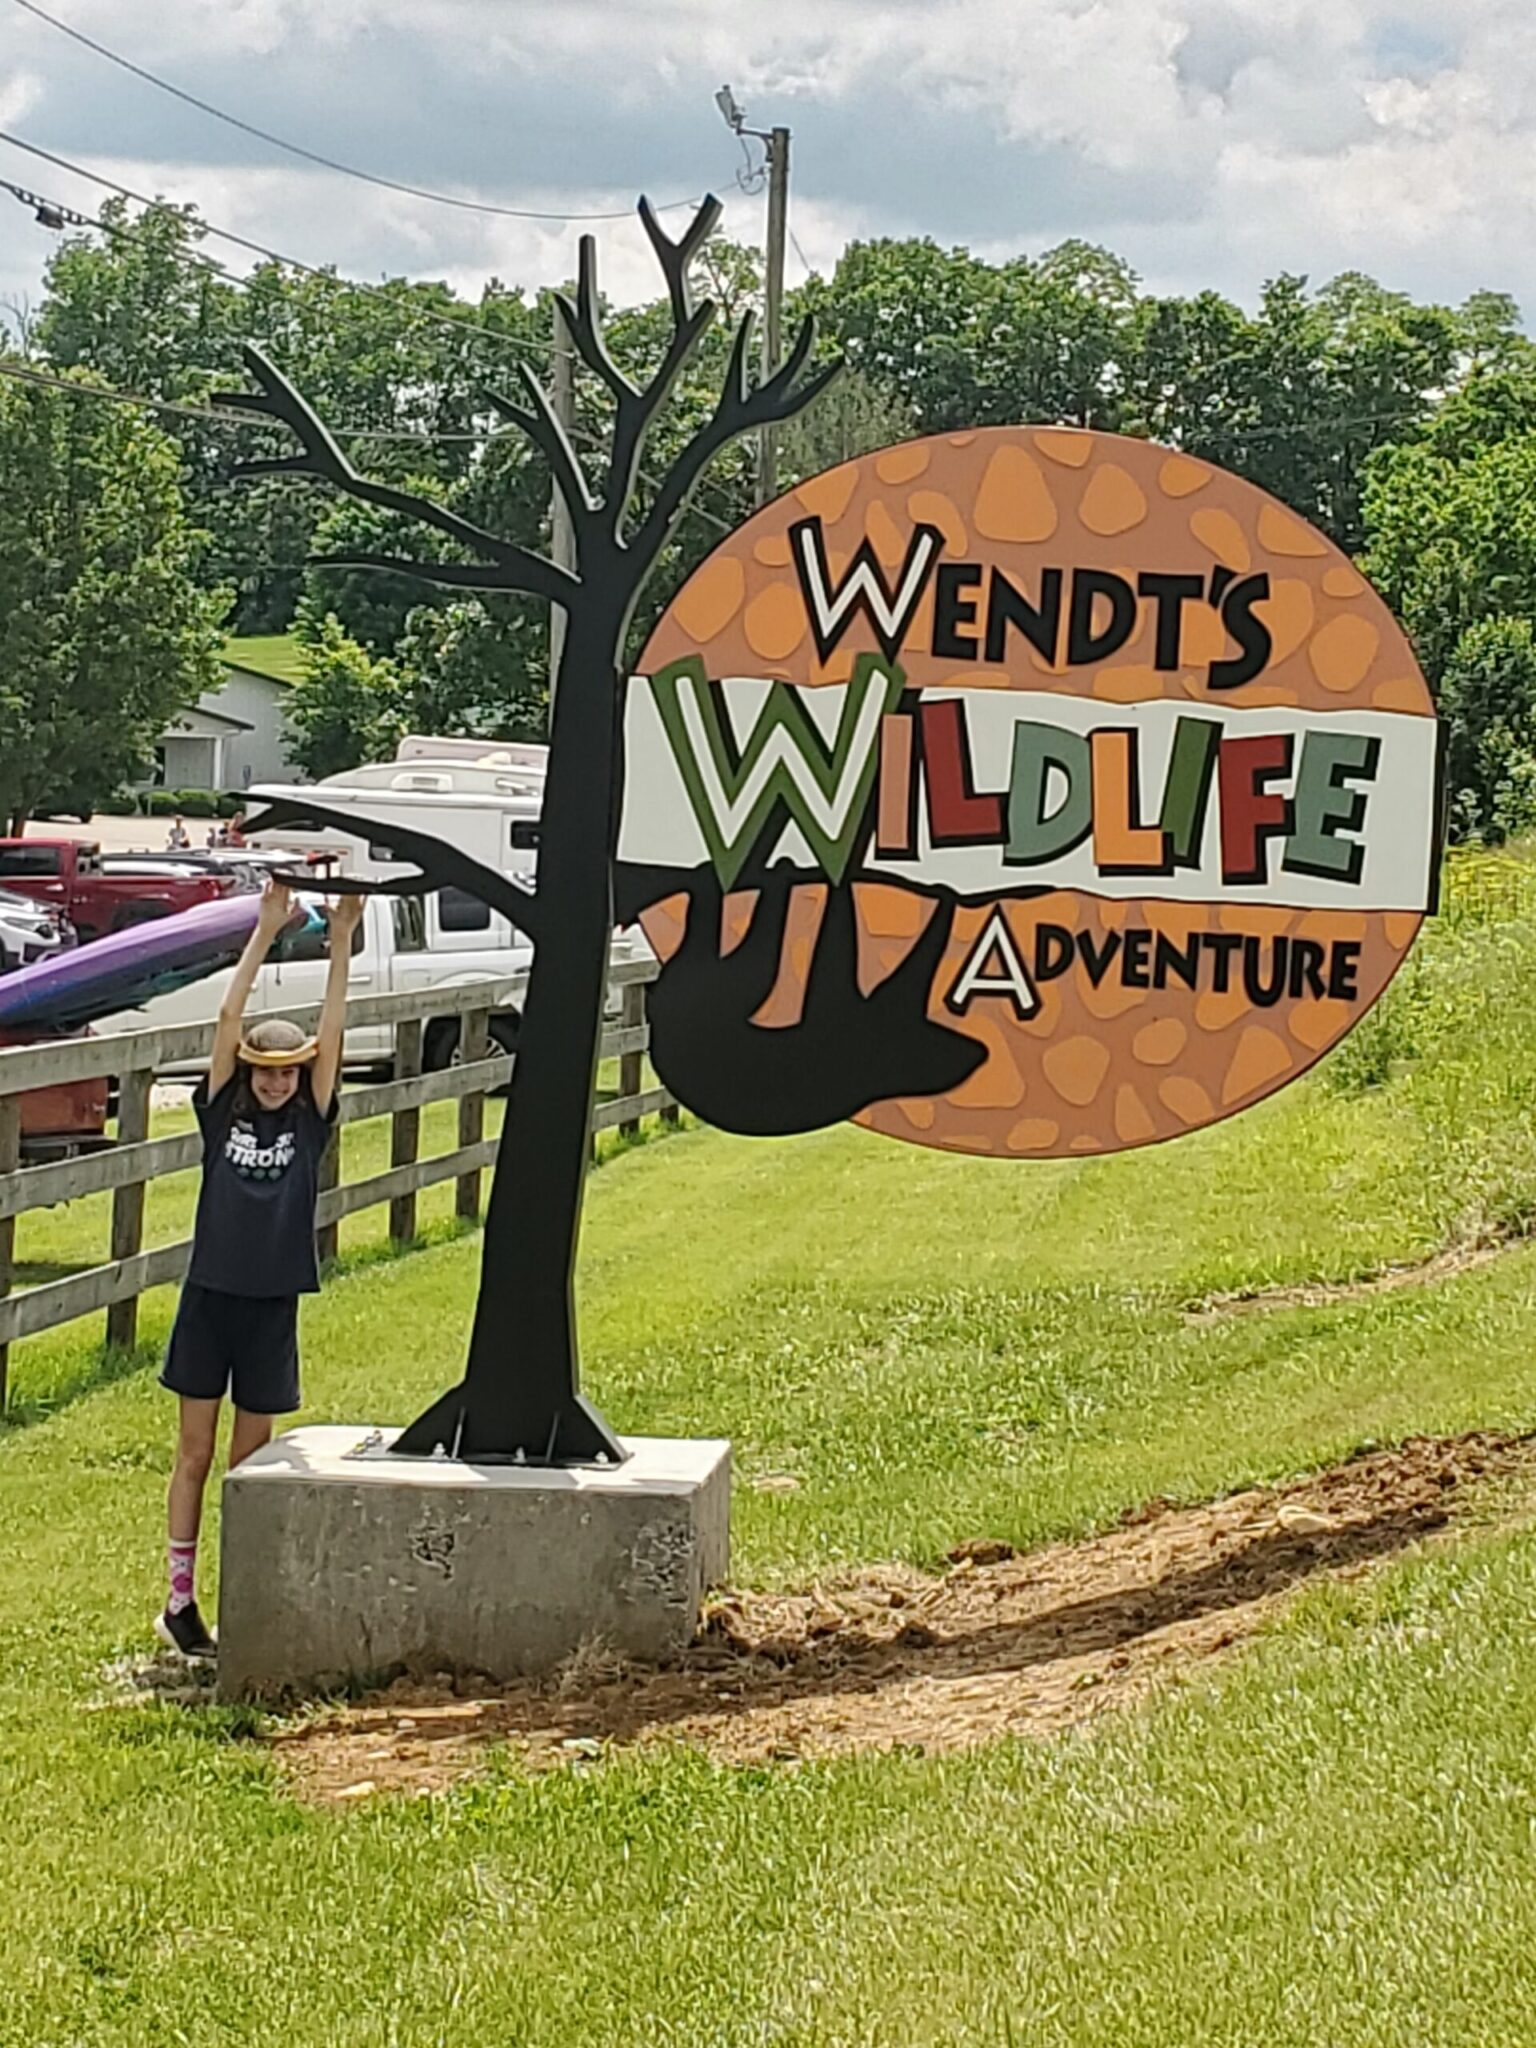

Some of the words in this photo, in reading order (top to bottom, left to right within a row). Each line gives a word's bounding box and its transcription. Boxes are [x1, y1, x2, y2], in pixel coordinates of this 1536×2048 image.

[790, 515, 1272, 689] WENDT'S
[650, 652, 1382, 893] WILDLIFE
[945, 904, 1362, 1020] ADVENTURE
